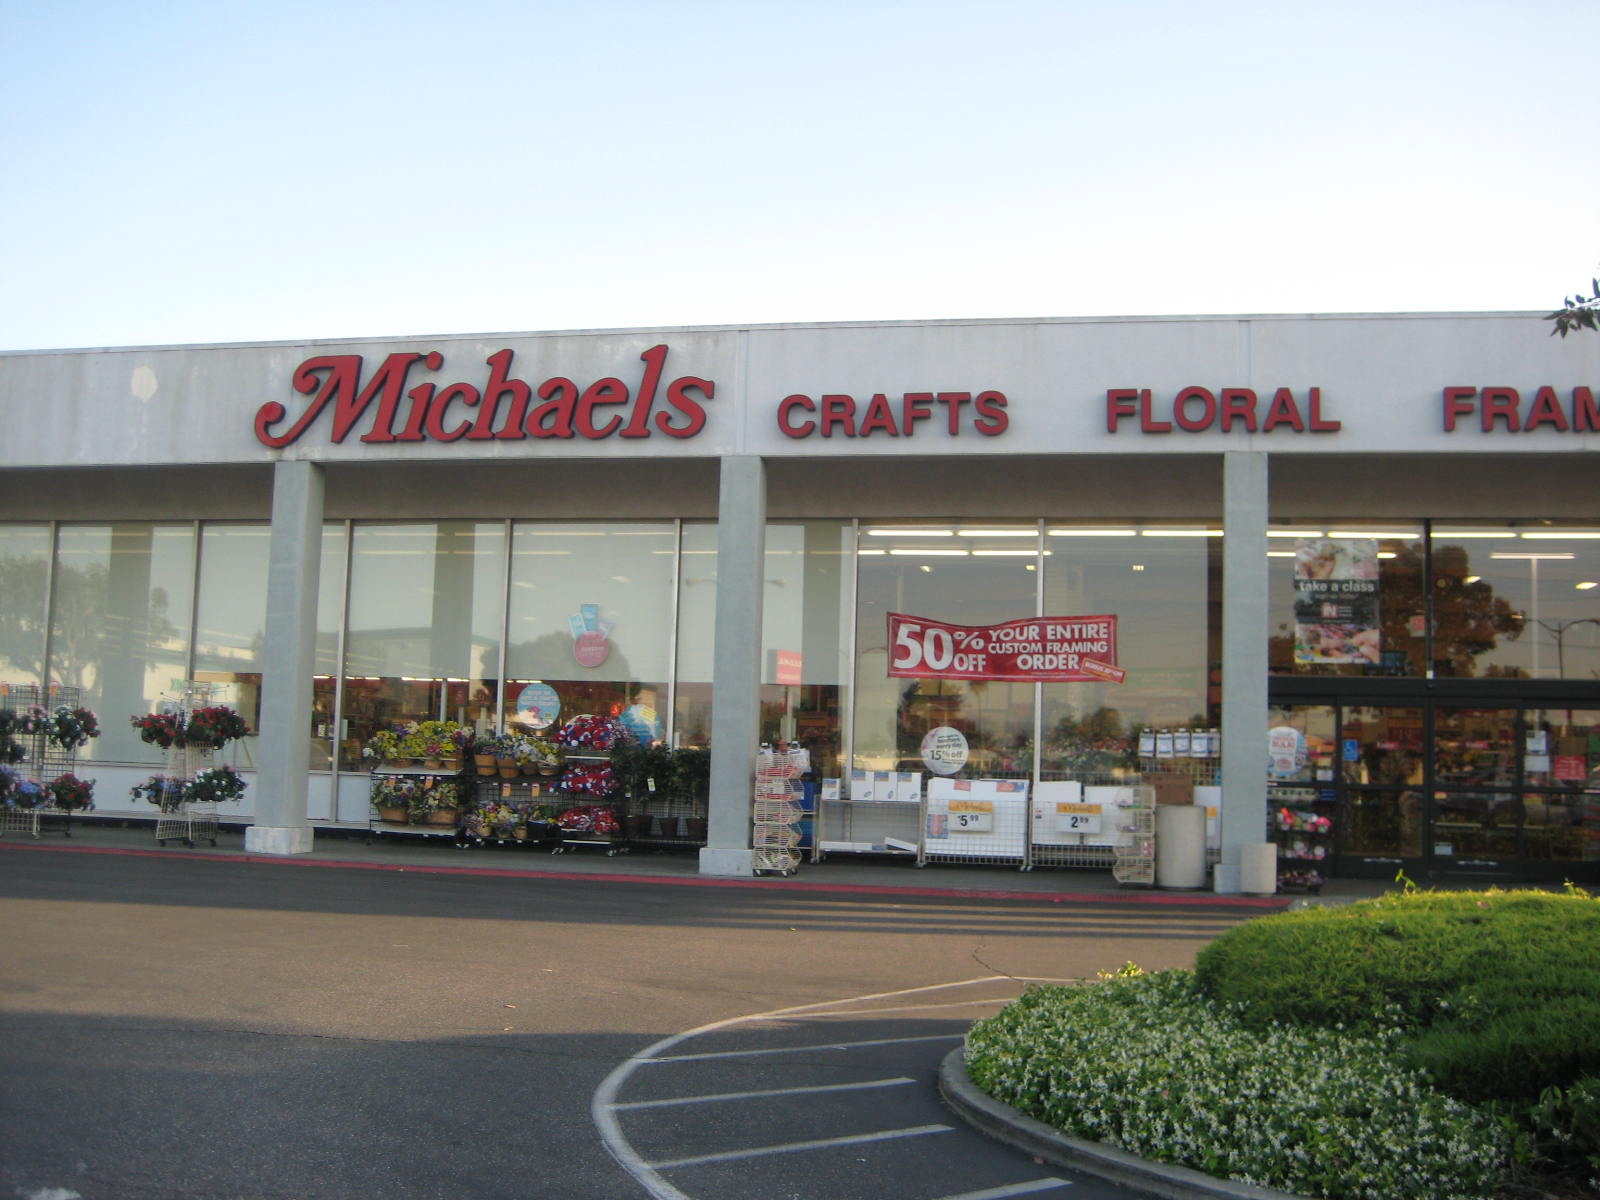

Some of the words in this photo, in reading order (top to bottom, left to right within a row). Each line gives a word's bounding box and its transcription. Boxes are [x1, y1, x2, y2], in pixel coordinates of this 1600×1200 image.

[254, 344, 715, 448] Michaels
[777, 390, 1010, 438] CRAFTS
[1107, 386, 1341, 433] FLORAL
[1443, 386, 1600, 433] FRAM
[1299, 581, 1327, 592] take
[1331, 583, 1339, 592] a
[1342, 581, 1375, 592] class
[988, 625, 1040, 642] YOUR
[1046, 623, 1109, 640] ENTIRE
[988, 641, 1041, 654] CUSTOM
[1046, 641, 1109, 653] FRAMING
[954, 654, 987, 672] OFF
[1016, 654, 1081, 670] ORDER
